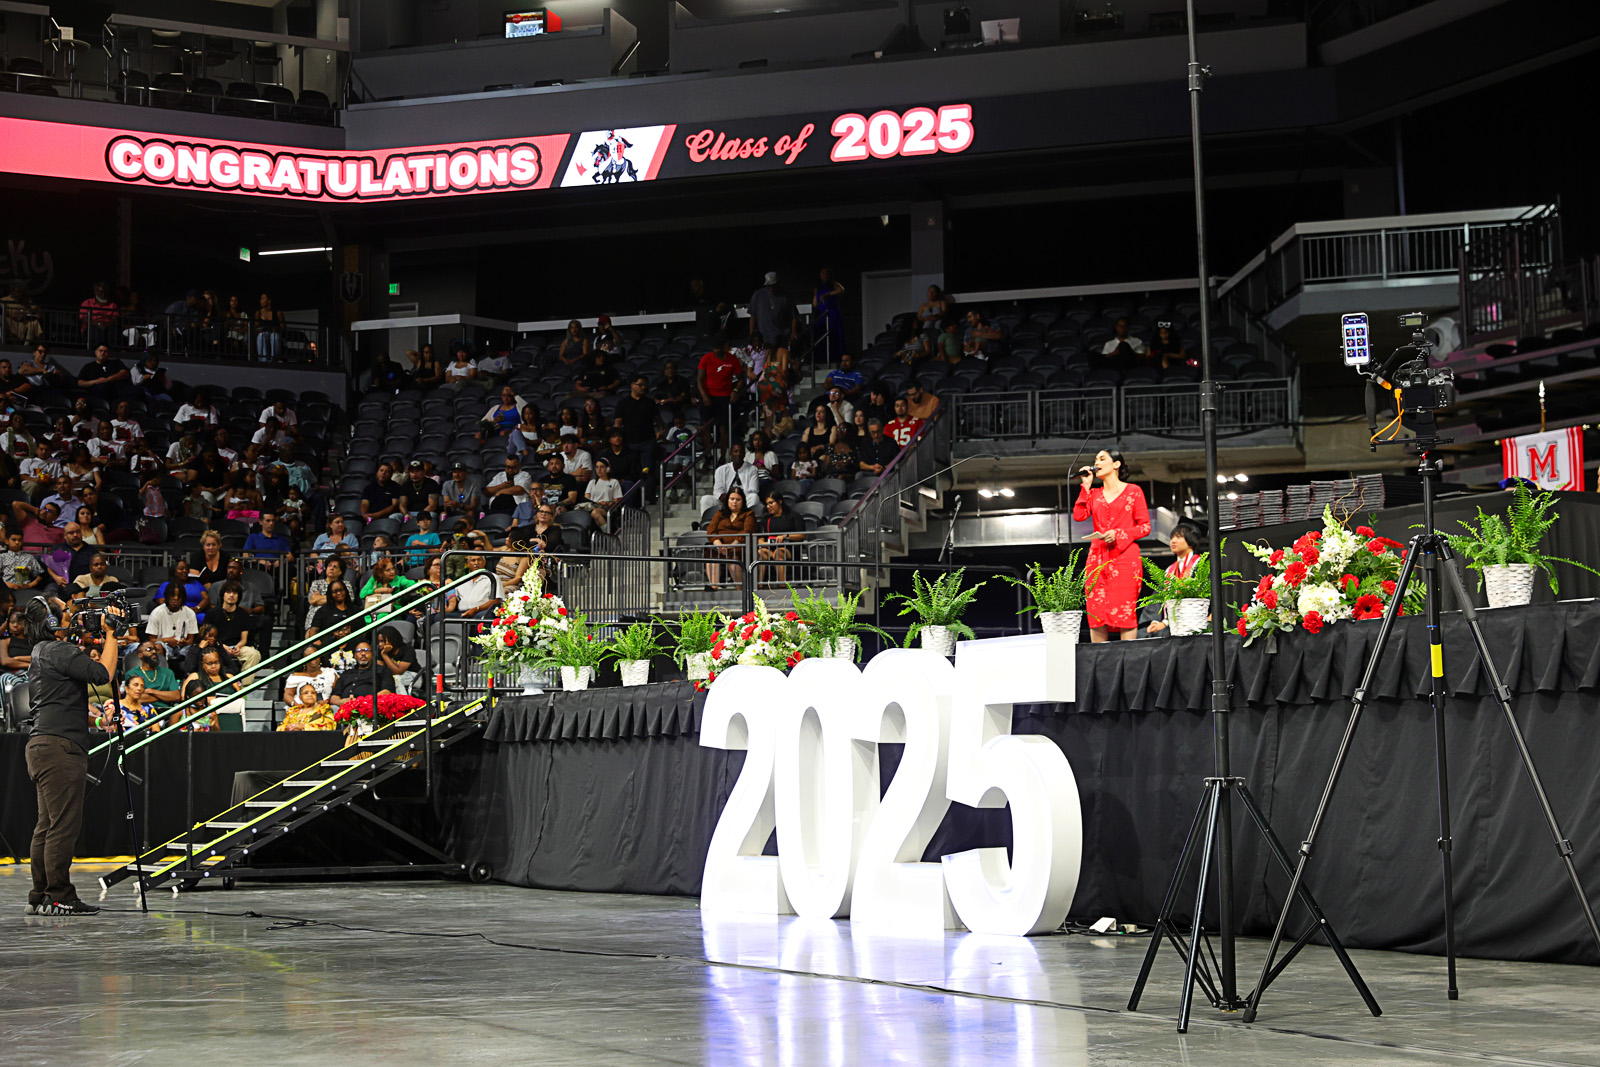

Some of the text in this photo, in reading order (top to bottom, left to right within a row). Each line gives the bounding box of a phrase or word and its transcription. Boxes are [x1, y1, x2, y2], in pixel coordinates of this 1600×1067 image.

[685, 104, 974, 165] Class of 2025
[108, 138, 540, 197] CONGRATULATIONS
[893, 427, 911, 446] 15
[1526, 440, 1560, 483] M
[699, 633, 1083, 937] 2025
